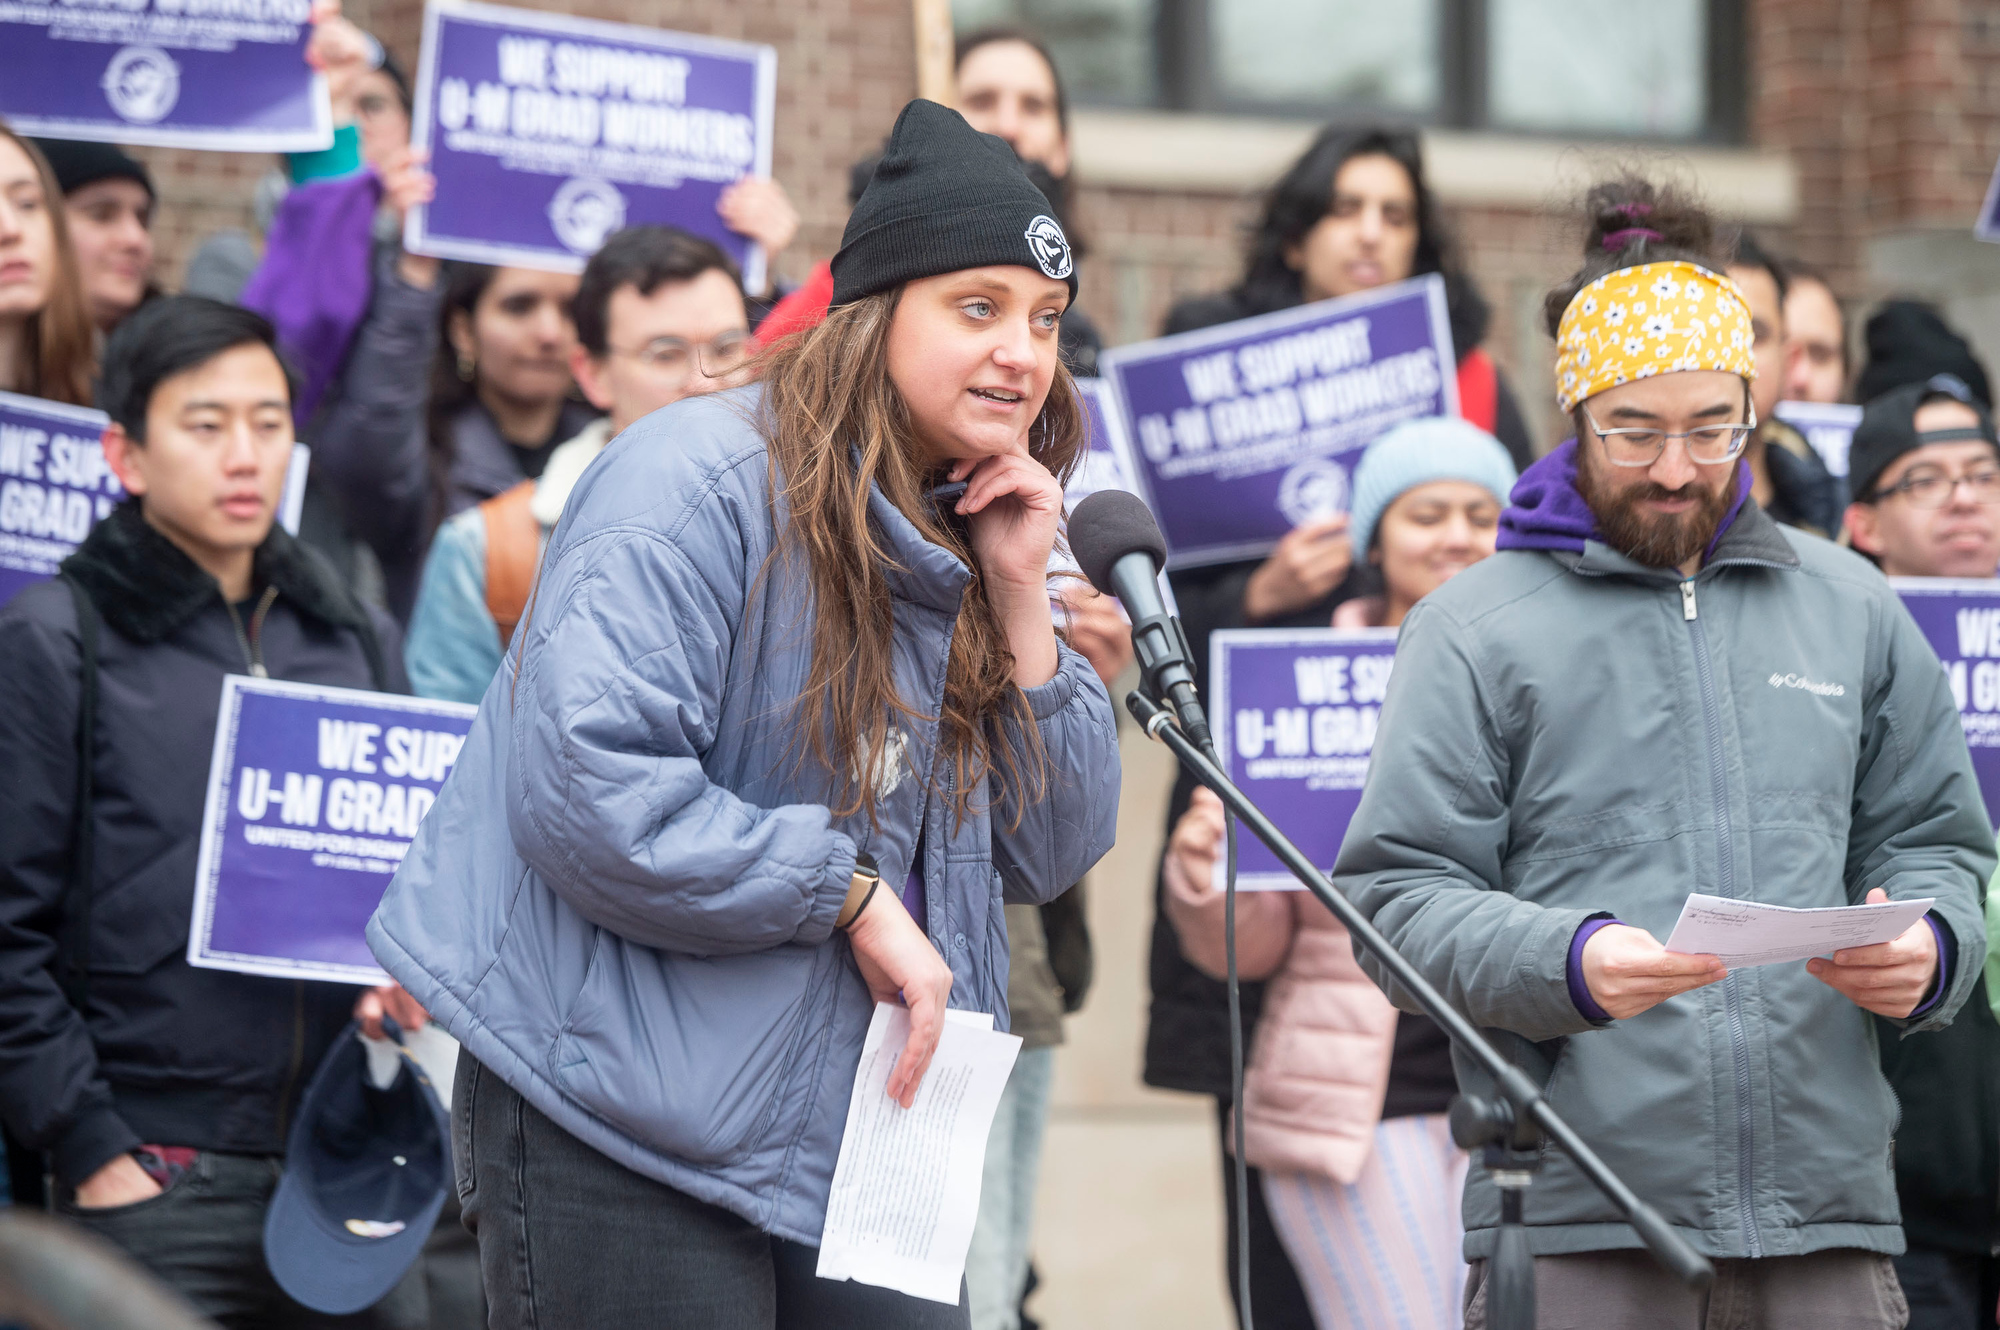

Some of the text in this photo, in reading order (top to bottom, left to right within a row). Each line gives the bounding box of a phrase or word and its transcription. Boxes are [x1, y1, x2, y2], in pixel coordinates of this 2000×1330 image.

[500, 36, 691, 105] WE SUPPORT
[440, 77, 511, 134] U-M
[512, 89, 601, 147] GRAD
[602, 103, 754, 167] WORKERS
[1041, 259, 1055, 275] JOIN
[1182, 317, 1372, 405] WE SUPPORT
[1139, 408, 1212, 463] U-M
[1209, 388, 1303, 450] GRAD
[1299, 347, 1440, 426] WORKERS
[0, 478, 92, 543] GRAD
[1294, 656, 1350, 704] WE
[319, 717, 467, 782] WE SUP
[1235, 707, 1309, 759] U-M
[238, 767, 436, 838] U-M GRAD
